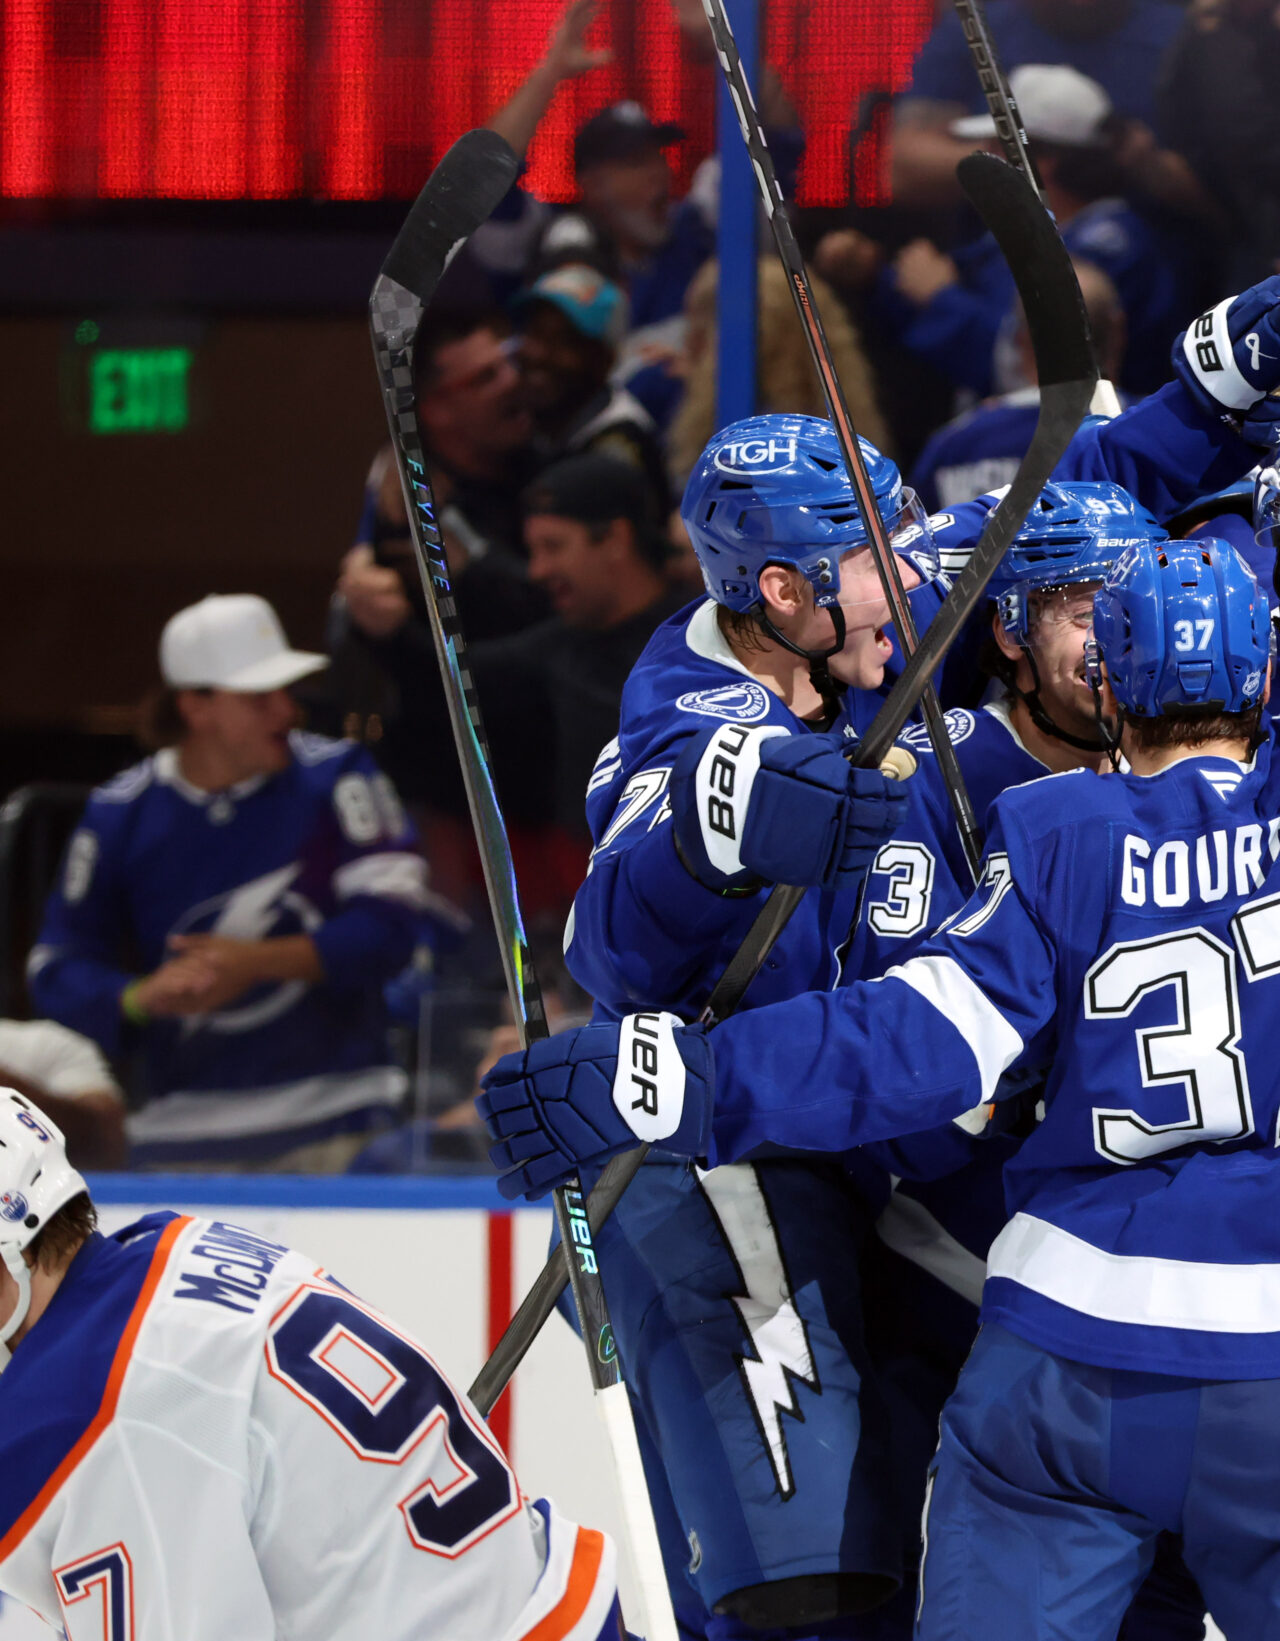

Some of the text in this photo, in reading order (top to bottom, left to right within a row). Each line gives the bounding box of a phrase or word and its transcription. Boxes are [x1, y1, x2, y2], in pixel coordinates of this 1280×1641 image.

[92, 350, 189, 432] EXIT
[724, 439, 796, 466] TGH
[407, 457, 450, 592] FLYLITE
[1085, 499, 1130, 516] 93
[1174, 619, 1214, 652] 37
[709, 726, 750, 841] BAU
[868, 840, 936, 938] 3
[930, 852, 1013, 938] 7
[631, 1014, 658, 1117] UER
[564, 1189, 599, 1275] UER
[265, 1267, 524, 1560] 9
[52, 1541, 134, 1641] 7
